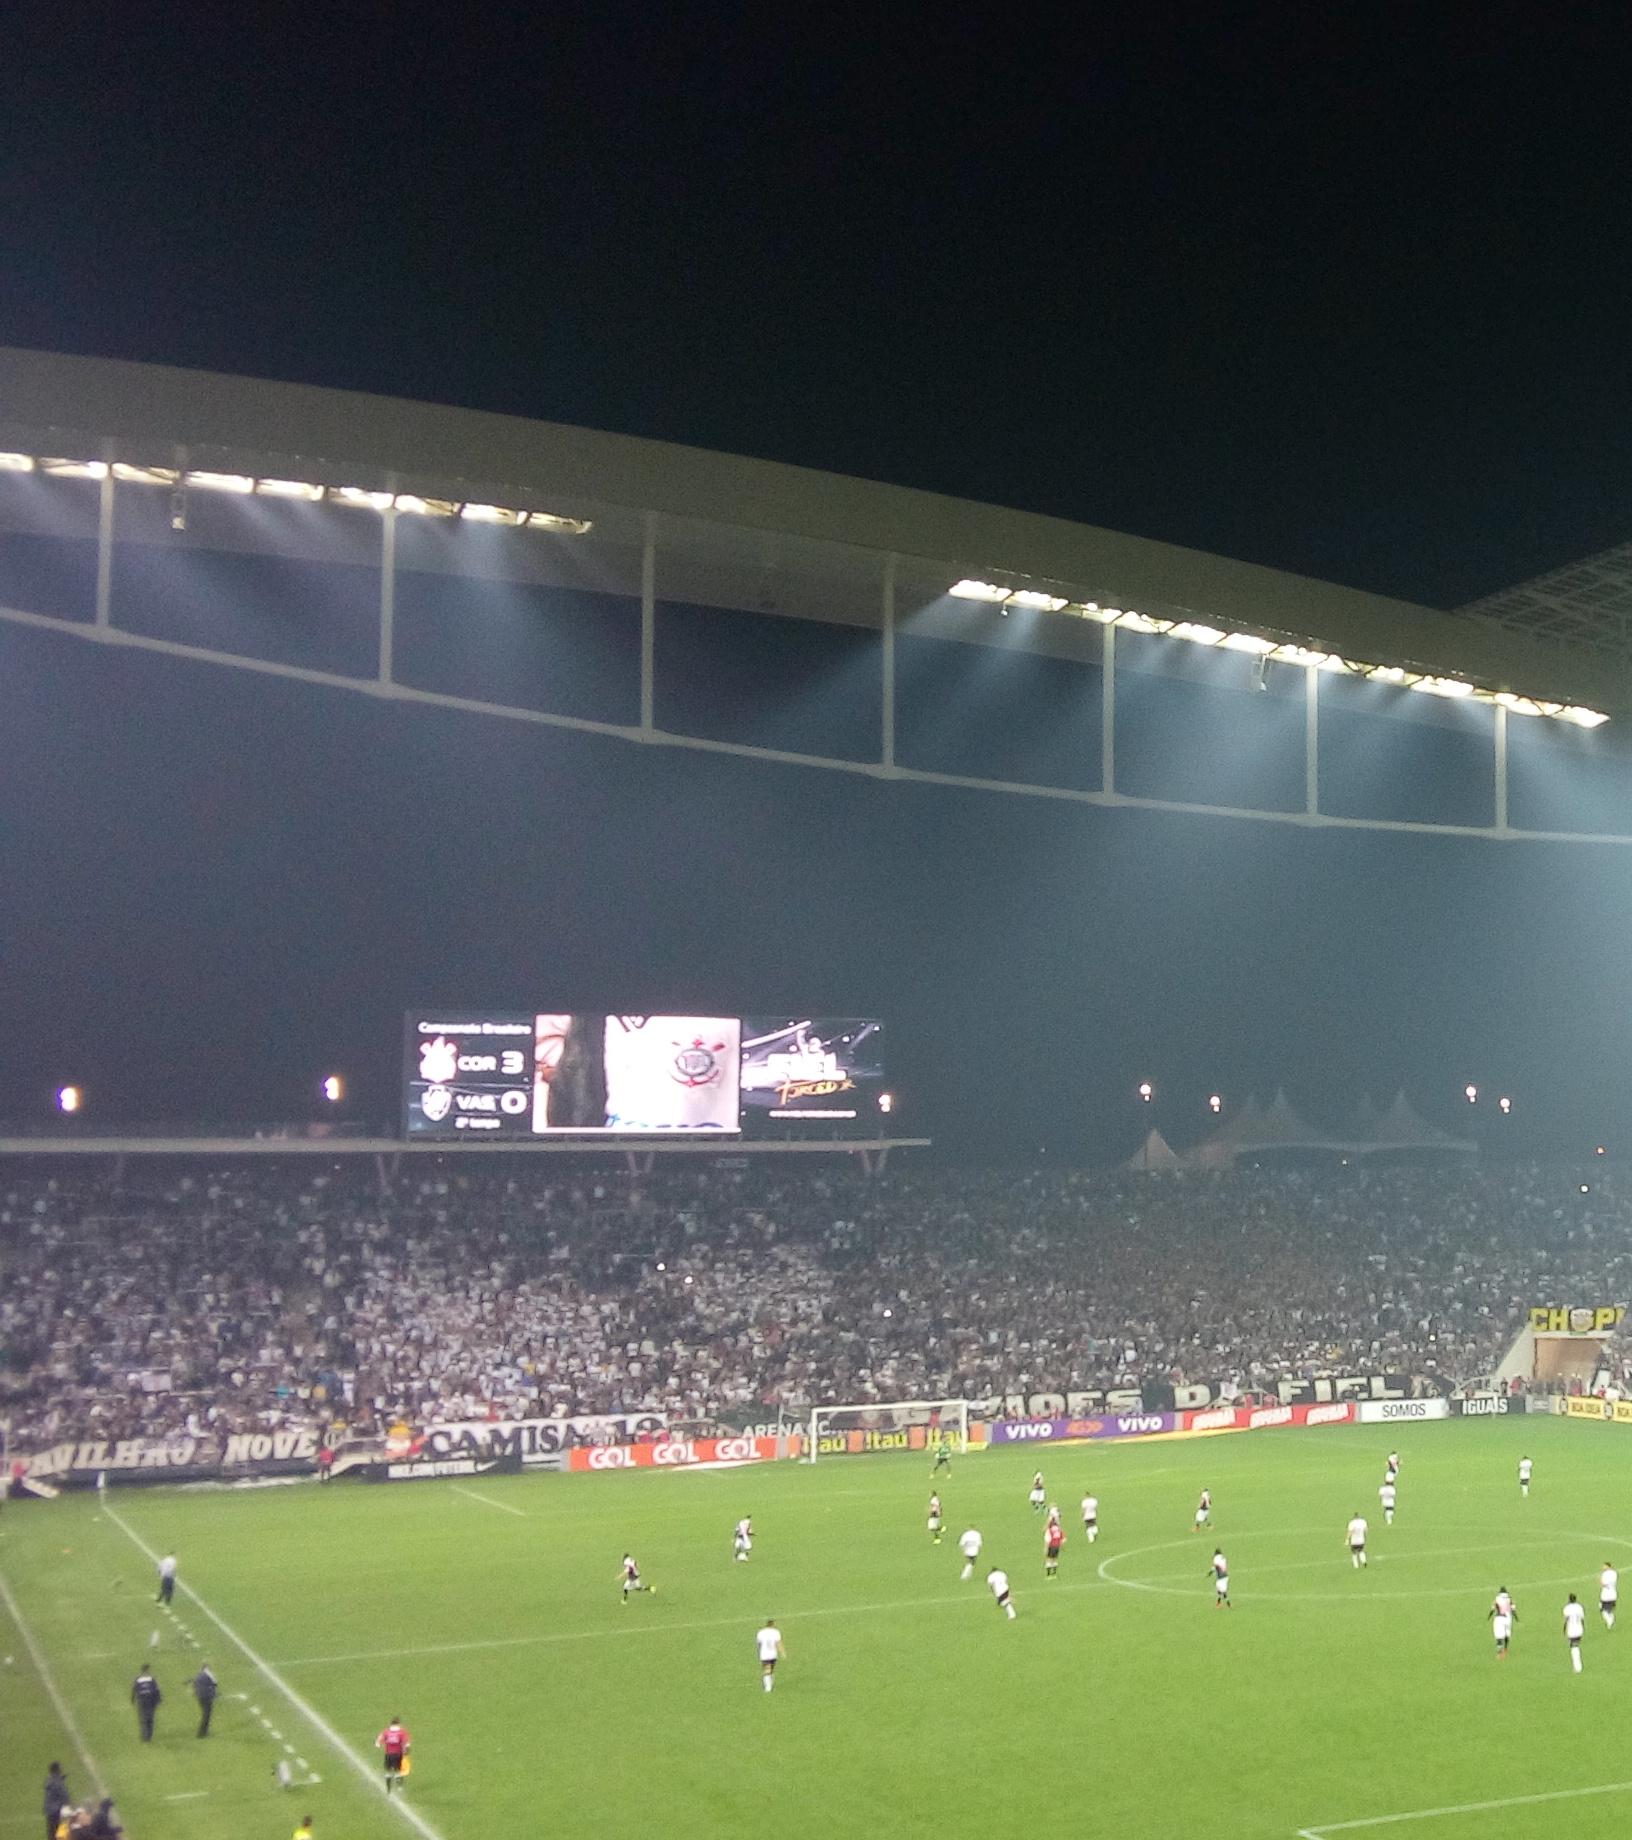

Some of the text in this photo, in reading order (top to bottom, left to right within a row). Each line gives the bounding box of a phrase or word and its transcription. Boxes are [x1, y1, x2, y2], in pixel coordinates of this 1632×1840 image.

[457, 1050, 524, 1075] COR 3
[456, 1095, 497, 1112] VAS
[1277, 1374, 1405, 1406] FIEL
[1382, 1403, 1426, 1418] SOMOS
[1462, 1397, 1508, 1416] IGUAIS
[743, 1421, 802, 1440] ARENA
[225, 1429, 319, 1464] NOVE
[588, 1436, 761, 1469] GOL GOL GOL
